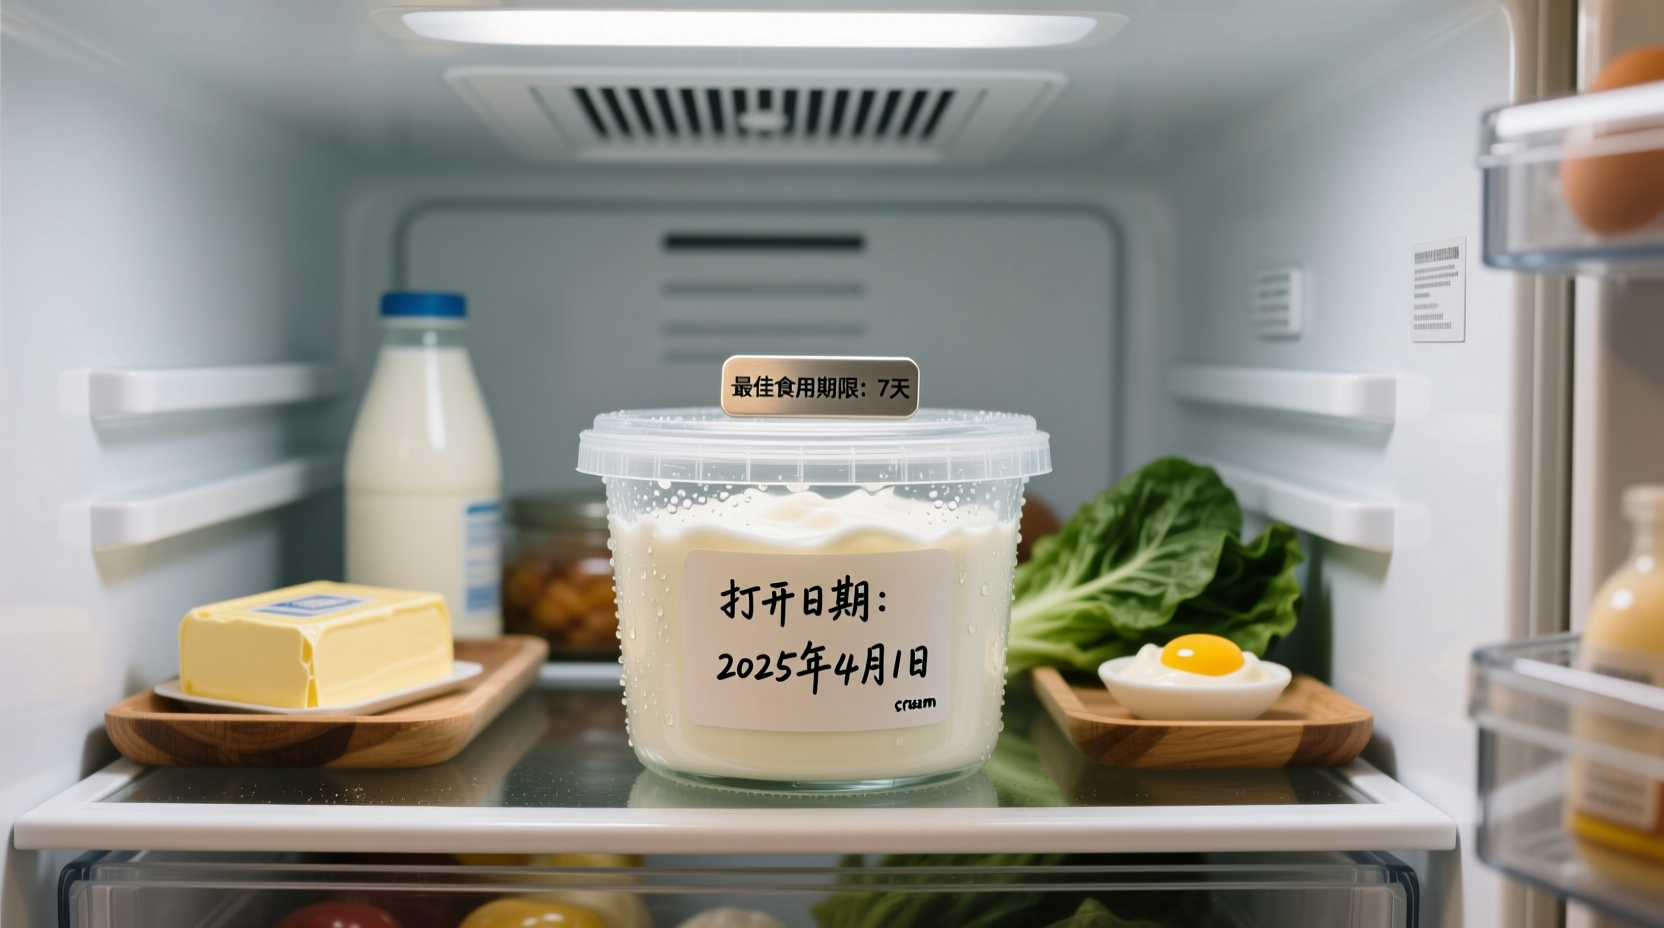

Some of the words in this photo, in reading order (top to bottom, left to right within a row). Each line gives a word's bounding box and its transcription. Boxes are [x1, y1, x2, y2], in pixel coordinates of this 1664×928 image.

[720, 574, 886, 627] 打开日期:
[716, 640, 928, 695] 2025年4月1日
